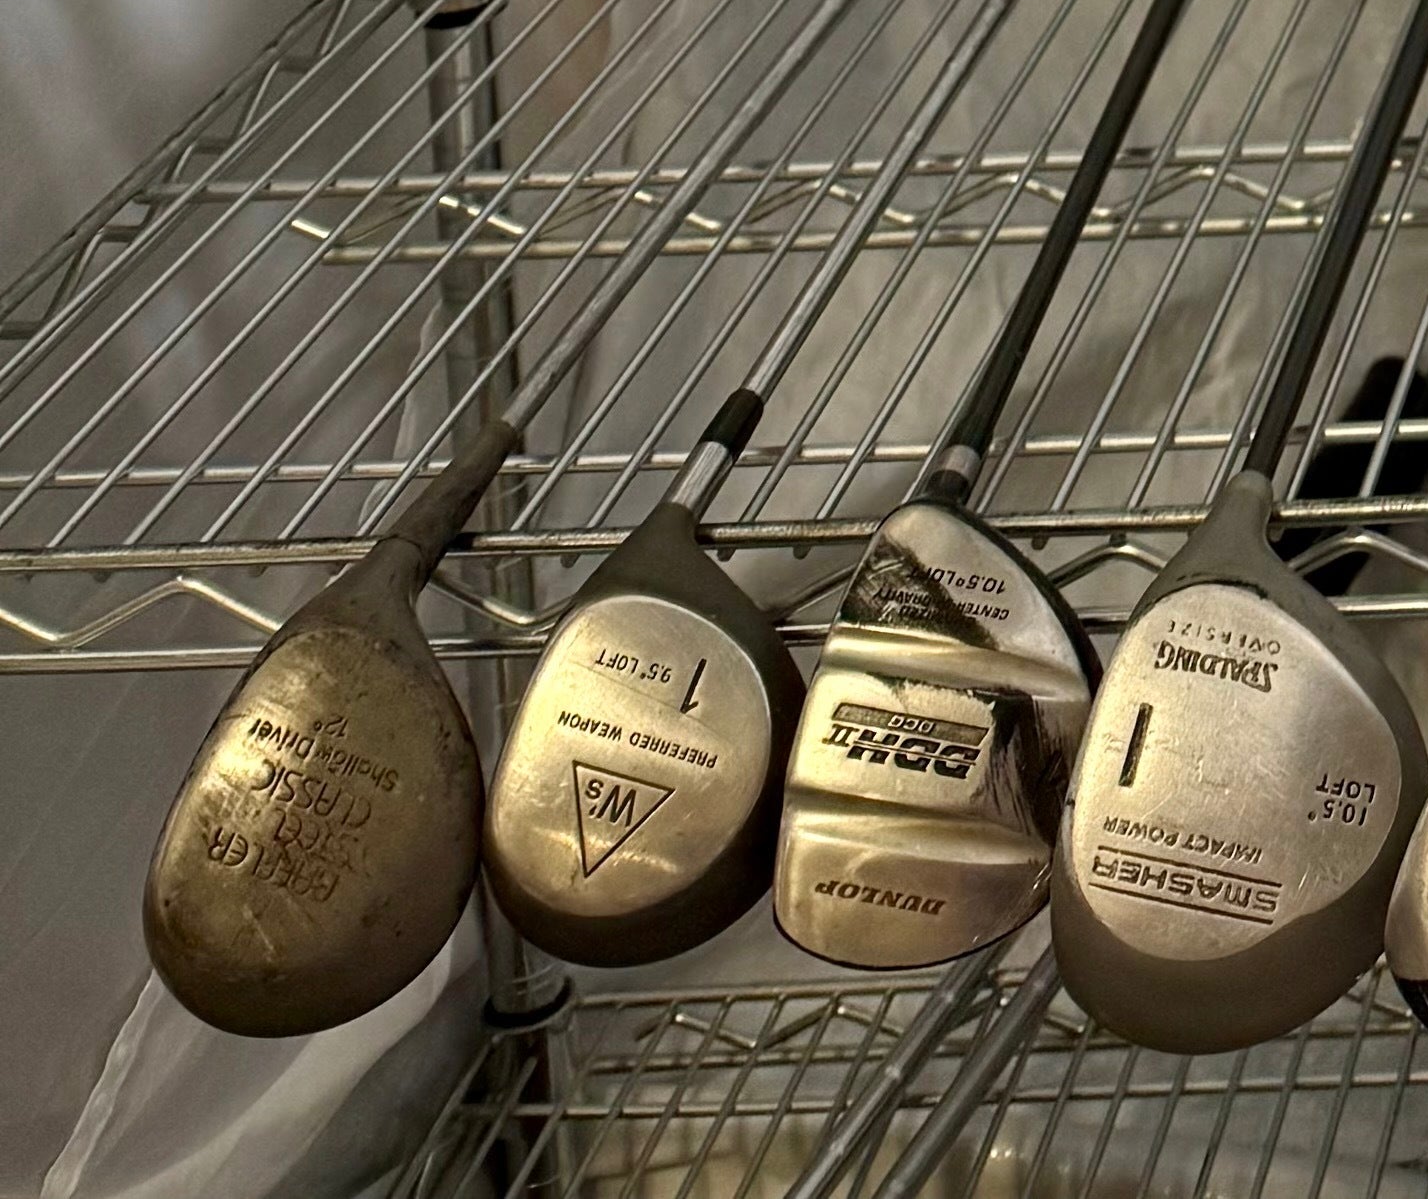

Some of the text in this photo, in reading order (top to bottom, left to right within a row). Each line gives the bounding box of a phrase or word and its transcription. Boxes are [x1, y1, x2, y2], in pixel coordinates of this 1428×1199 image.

[594, 648, 638, 675] LOFT
[679, 657, 708, 715] 1
[1153, 639, 1279, 693] SPALDING
[248, 717, 317, 758] Driver
[557, 709, 719, 769] PREFERRED WEAPON
[846, 729, 981, 780] DDH
[251, 762, 373, 830] CLASSIC
[1315, 772, 1377, 803] LOFT
[1102, 814, 1262, 864] IMPACT POWER
[814, 880, 945, 916] DUNLOP
[1091, 854, 1279, 916] SMASHER
